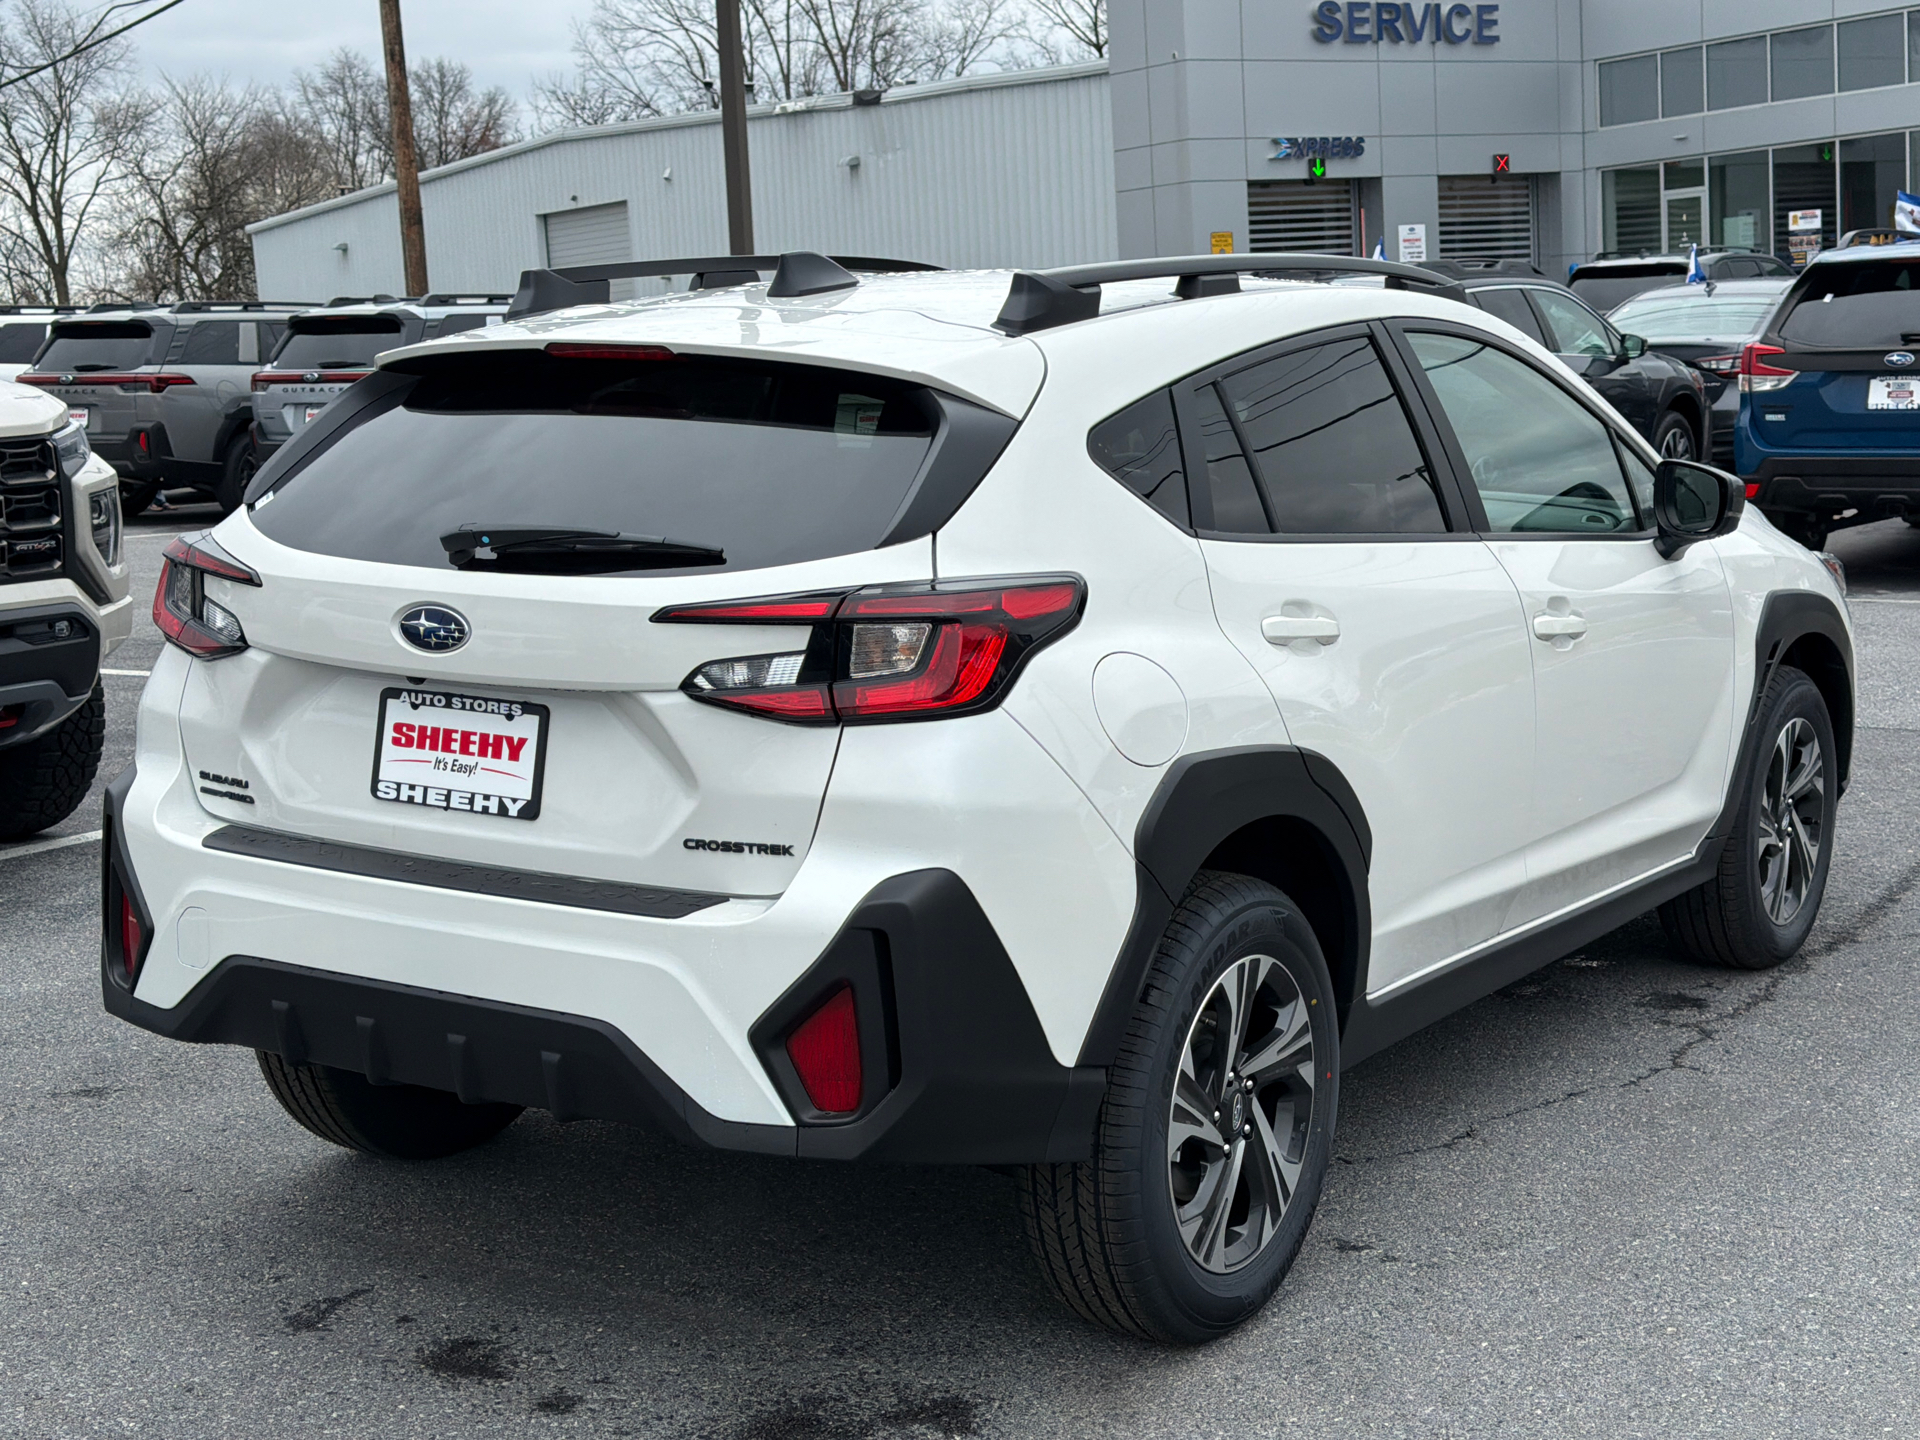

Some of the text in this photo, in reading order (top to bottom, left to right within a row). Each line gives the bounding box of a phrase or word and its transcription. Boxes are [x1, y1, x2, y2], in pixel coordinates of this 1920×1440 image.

[1314, 0, 1500, 43] SERVICE
[1268, 137, 1365, 159] EXPRESS
[399, 691, 523, 717] AUTO STORES
[391, 721, 529, 763] SHEEHY
[433, 756, 479, 778] It's Easy!
[199, 770, 249, 789] SUBARU
[376, 781, 528, 817] SHEEHY
[683, 838, 795, 857] CROSSTREK
